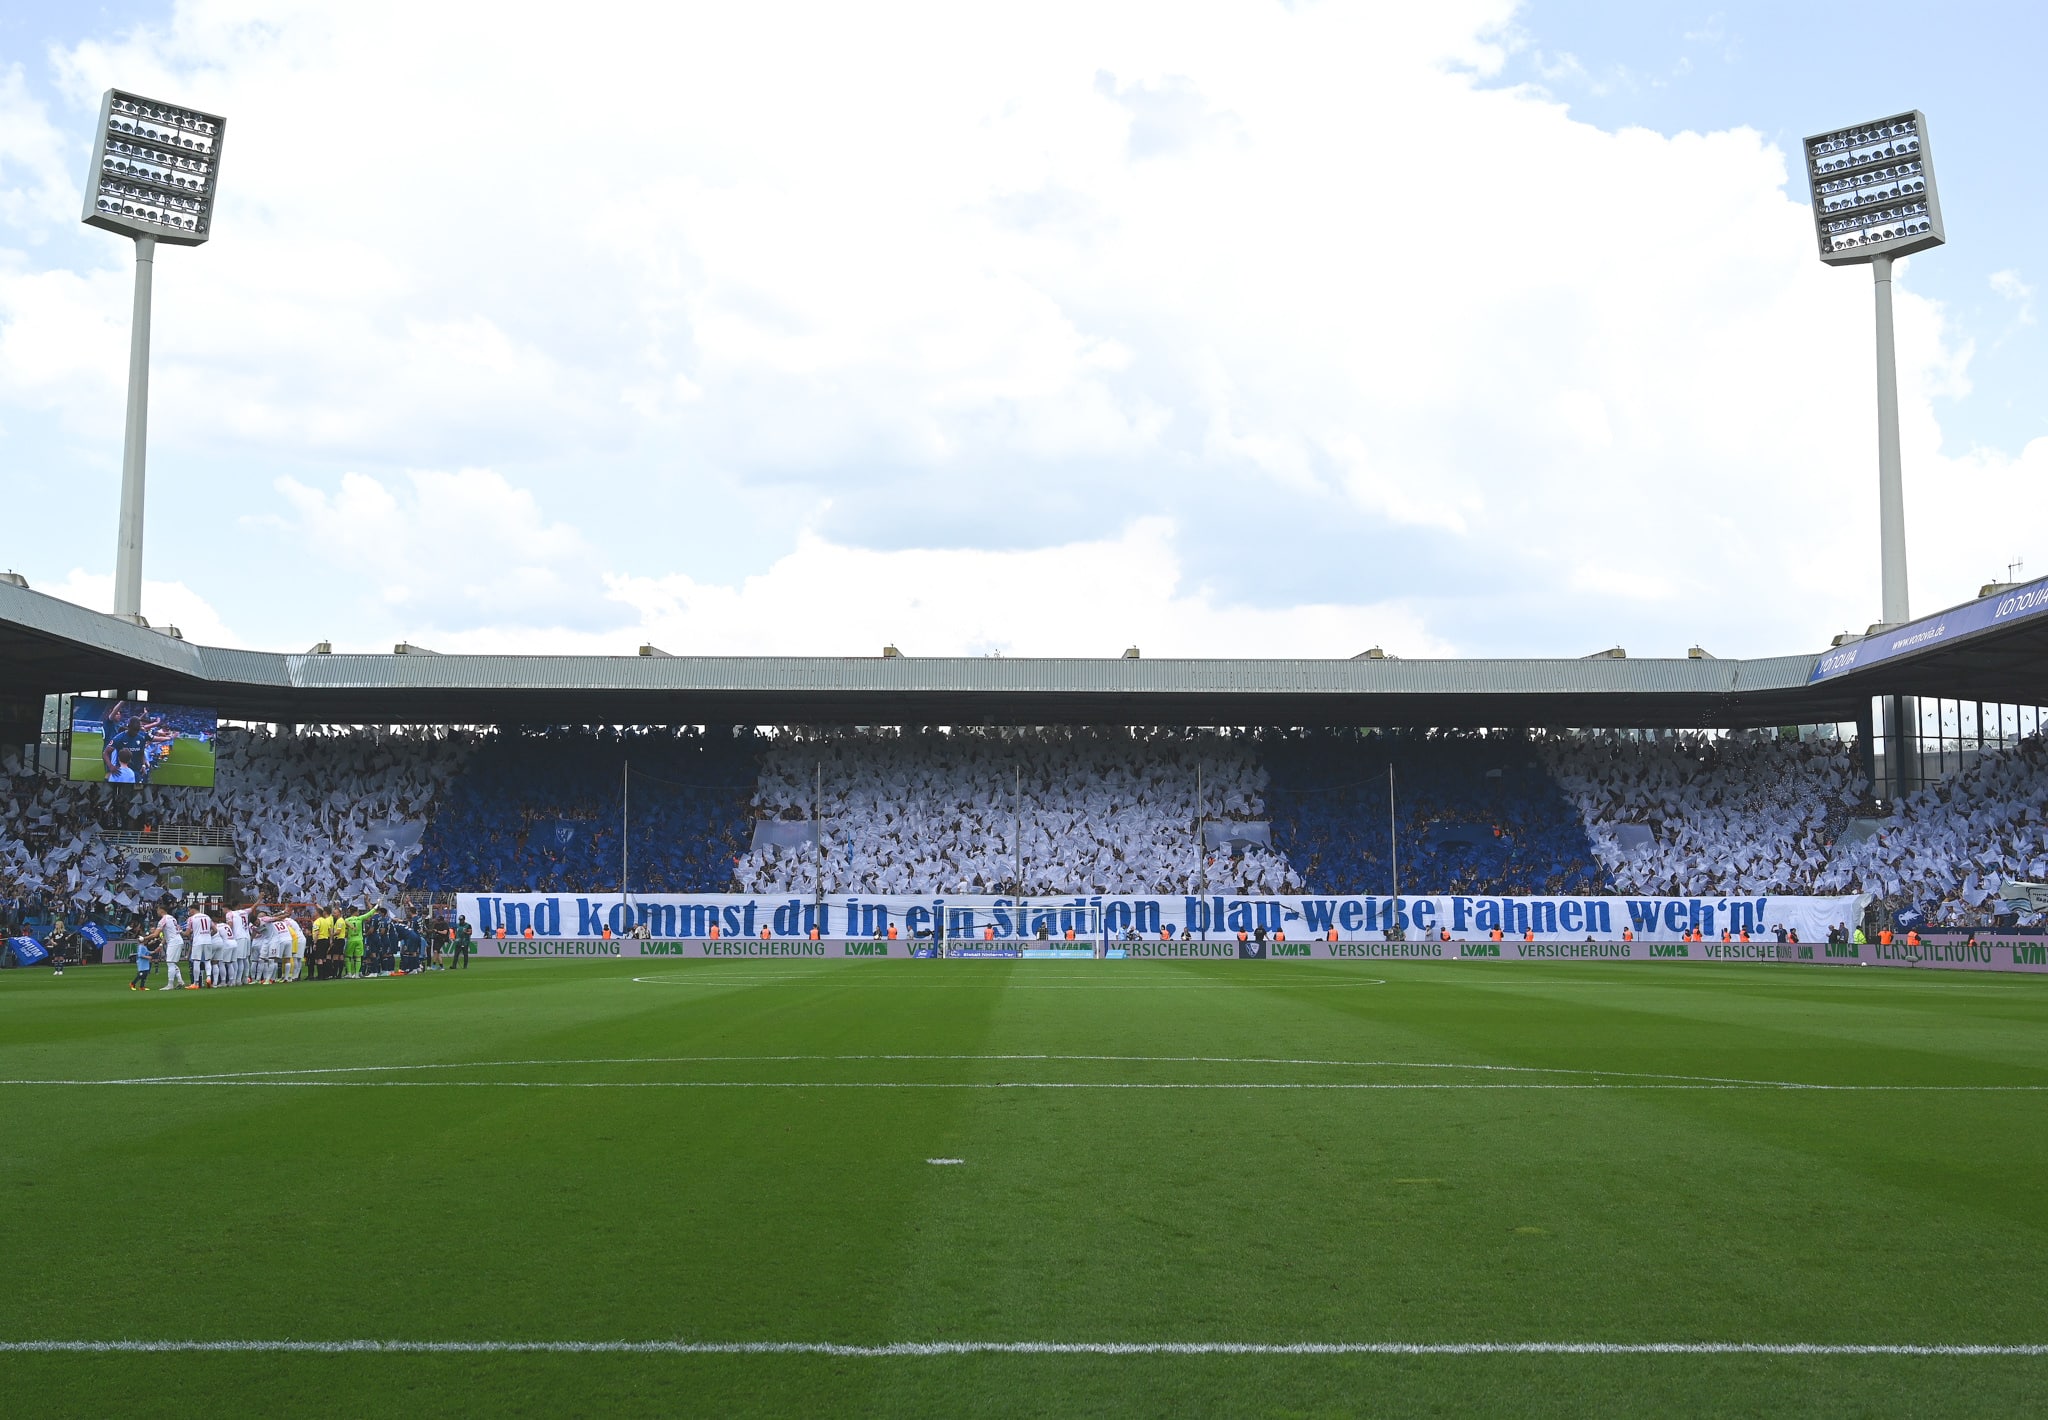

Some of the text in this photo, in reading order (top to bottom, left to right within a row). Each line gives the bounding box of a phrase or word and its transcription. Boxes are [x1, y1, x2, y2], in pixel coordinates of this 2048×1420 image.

[1892, 624, 1945, 650] www.vonovia.de
[476, 897, 561, 936] Und
[576, 898, 758, 937] kommst
[773, 899, 830, 936] du
[846, 897, 888, 937] in
[905, 899, 974, 939] ein
[993, 895, 1176, 938] Stadion,
[1185, 896, 1436, 933] blau-weiße
[1452, 896, 1612, 934] Fahnen
[200, 918, 208, 931] 11
[274, 922, 286, 932] 13
[224, 926, 233, 937] 3
[497, 941, 620, 955] VERSICHERUNG
[640, 942, 825, 955] LVM VERSICHERUNG
[845, 942, 876, 955] LVM
[1111, 943, 1233, 957] VERSICHERUNG
[1271, 943, 1298, 956] LVM
[1328, 944, 1442, 957] VERSICHERUNG
[1461, 944, 1630, 957] LVM VERSICHERUNG
[1649, 945, 1677, 957] LVM
